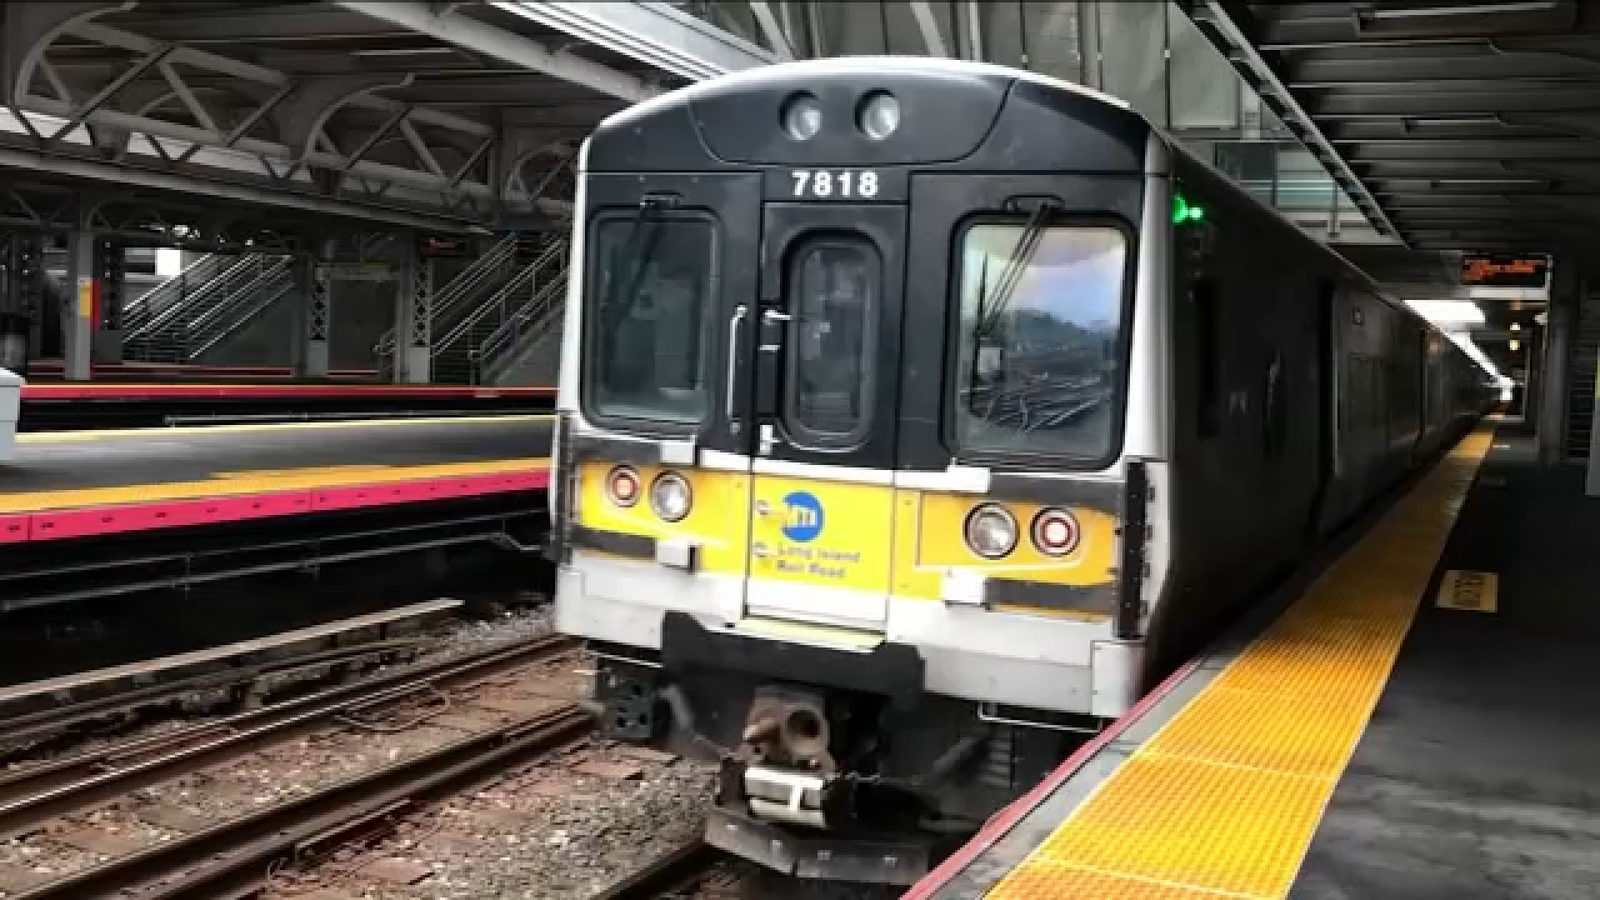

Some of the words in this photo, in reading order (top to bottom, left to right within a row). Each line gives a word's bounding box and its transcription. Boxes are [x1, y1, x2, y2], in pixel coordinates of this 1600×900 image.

[792, 170, 878, 198] 7818
[777, 543, 812, 560] Long
[817, 547, 861, 563] Island
